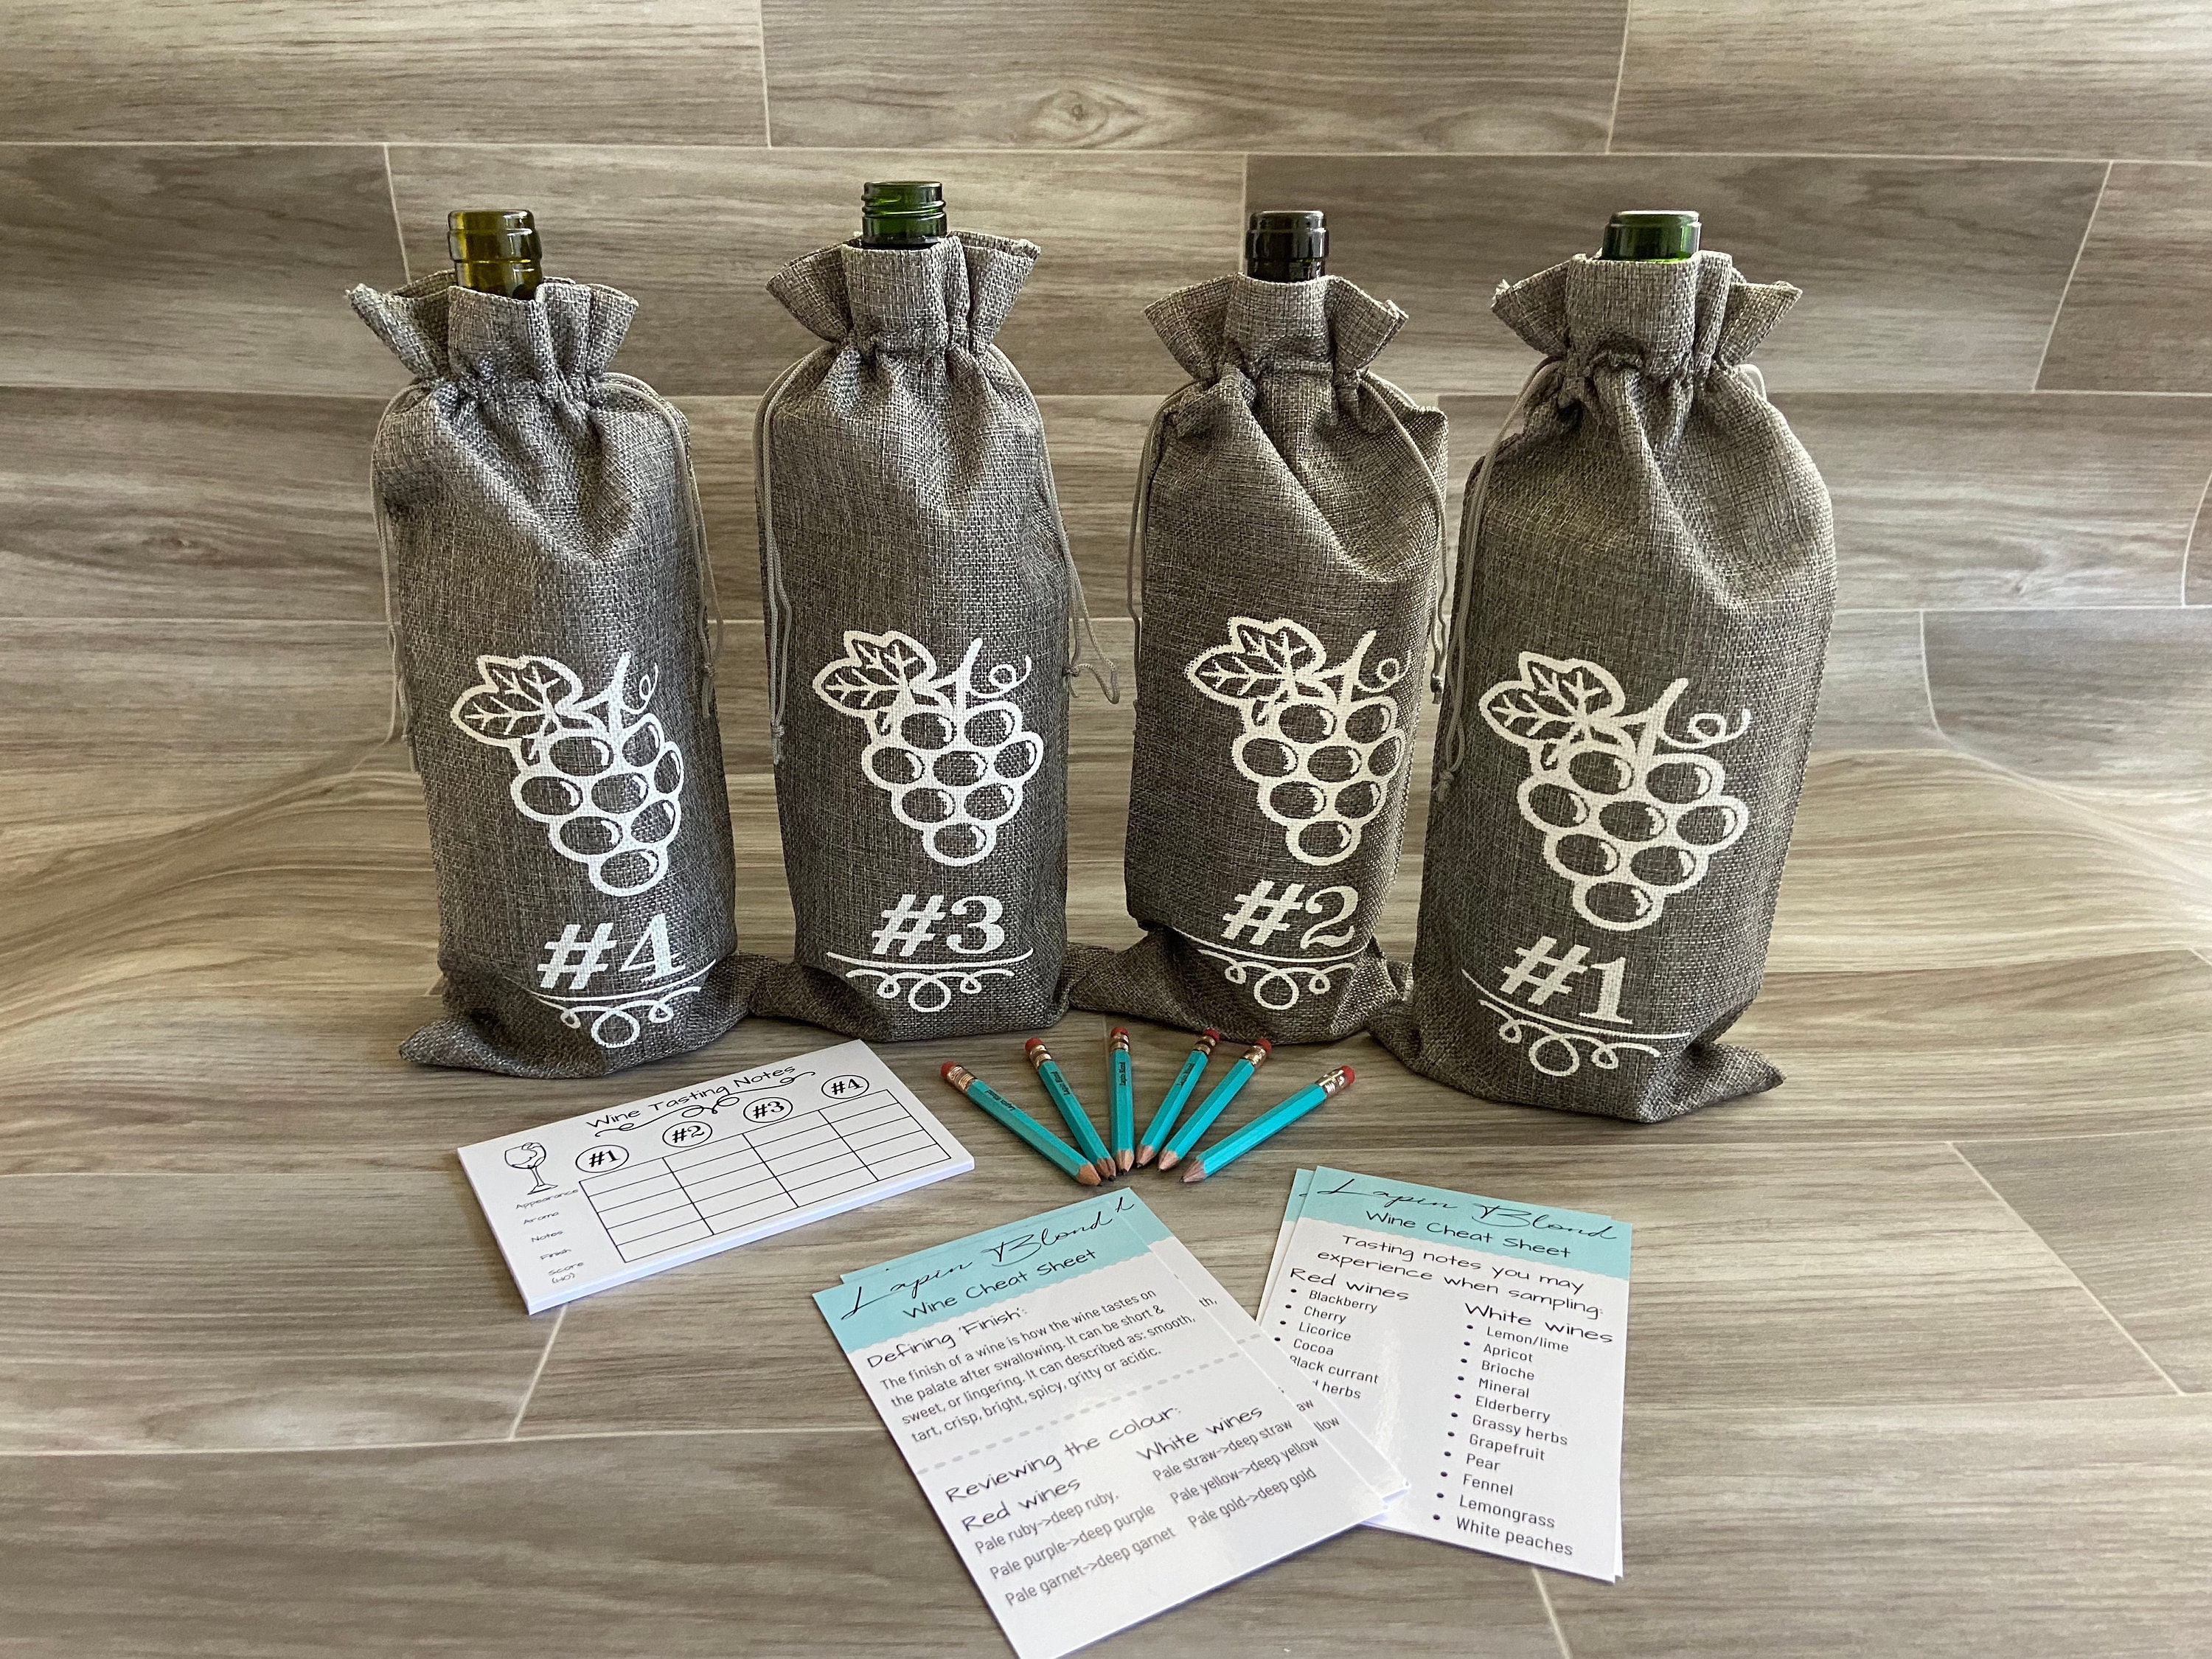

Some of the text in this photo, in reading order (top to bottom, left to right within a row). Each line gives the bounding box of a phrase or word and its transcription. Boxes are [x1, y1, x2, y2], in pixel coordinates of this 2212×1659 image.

[871, 893, 1005, 957] #3
[1221, 879, 1359, 950] #2
[537, 913, 686, 990] #4
[1500, 936, 1633, 1025] #1
[587, 1066, 795, 1128] Wine Tasting Notes
[831, 1078, 862, 1096] #4
[753, 1101, 785, 1119] #3
[672, 1125, 704, 1143] #2
[588, 1150, 620, 1167] #1
[516, 1189, 578, 1209] Appearance
[1316, 1178, 1617, 1240] Lapin Blond
[524, 1211, 559, 1225] Aroma
[1366, 1209, 1572, 1259] Wine Cheat Sheet
[531, 1231, 563, 1242] Notes
[549, 1262, 583, 1276] Score
[841, 1211, 1113, 1320] Lapin Blond
[1317, 1251, 1433, 1281] experience
[1444, 1274, 1499, 1295] when
[1342, 1235, 1585, 1295] Tasting notes you may
[903, 1249, 1096, 1318] Wine Cheat Sheet
[1290, 1267, 1410, 1301] Red wines
[1304, 1306, 1346, 1324] Cherry
[1309, 1290, 1377, 1314] Blackberry
[1298, 1321, 1352, 1341] Licorice
[1464, 1302, 1614, 1344] White wines
[1486, 1325, 1570, 1353] Lemon/lime
[867, 1334, 956, 1368] Defining
[880, 1290, 1157, 1391] The finish of a wine is how the wine tastes on
[891, 1304, 1164, 1408] the palate after swallowing. It can be short &
[1293, 1338, 1334, 1356] Cocoa
[1483, 1343, 1534, 1363] Apricot
[902, 1314, 1196, 1425] sweet, or lingering. It can described as: smooth,
[1328, 1365, 1380, 1384] currant
[1481, 1360, 1535, 1382] Brioche
[911, 1346, 1161, 1443] tart, crisp, bright, spicy, gritty or acidic.
[1322, 1381, 1361, 1399] herbs
[1478, 1377, 1529, 1399] Mineral
[1475, 1395, 1551, 1424] Elderberry
[1136, 1407, 1263, 1461] White wines
[1472, 1413, 1569, 1447] Grassy herbs
[945, 1407, 1181, 1503] Reviewing the colour:
[1152, 1463, 1182, 1481] Pale
[1259, 1419, 1293, 1439] straw
[1465, 1453, 1501, 1472] Pear
[1469, 1433, 1546, 1462] Grapefruit
[1169, 1485, 1200, 1505] Pale
[1281, 1437, 1319, 1462] yellow
[1462, 1473, 1514, 1497] Fennel
[961, 1478, 1081, 1532] Red wines
[1187, 1509, 1218, 1528] Pale
[1290, 1467, 1317, 1486] gold
[1458, 1495, 1555, 1529] Lemongrass
[975, 1534, 1006, 1554] Pale
[990, 1559, 1021, 1580] Pale
[1113, 1503, 1155, 1531] purple
[1455, 1516, 1573, 1557] White peaches
[1005, 1587, 1037, 1607] Pale
[1132, 1526, 1176, 1556] garnet
